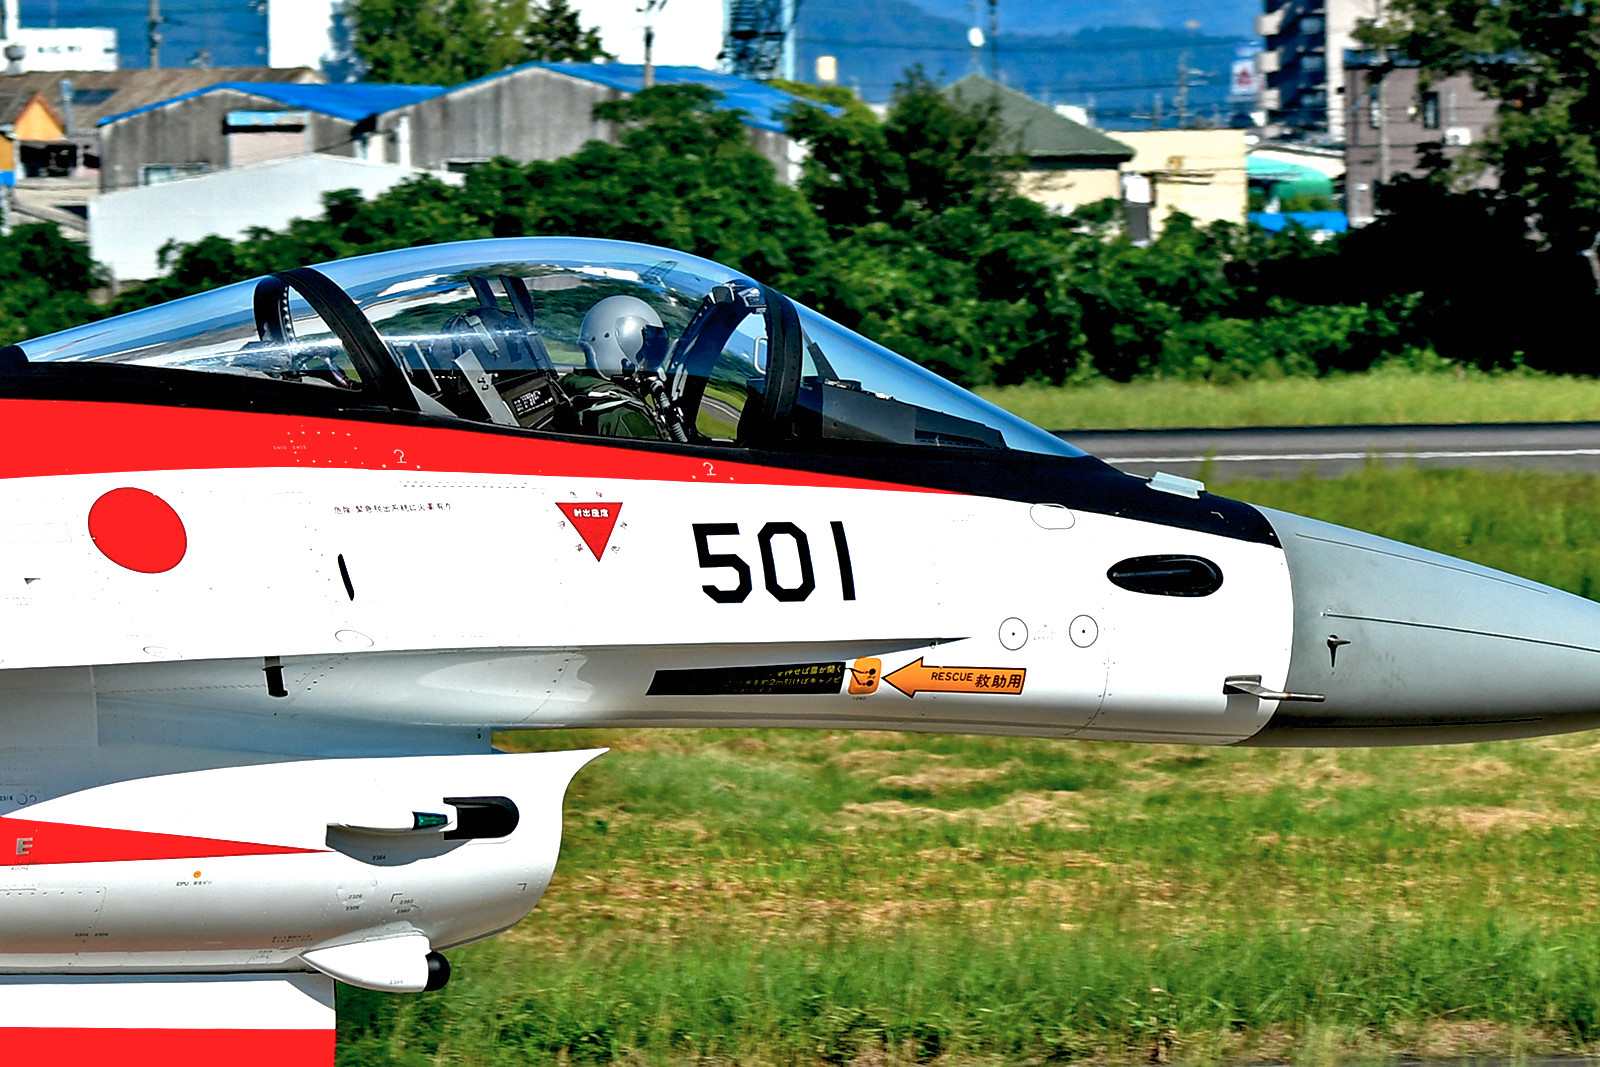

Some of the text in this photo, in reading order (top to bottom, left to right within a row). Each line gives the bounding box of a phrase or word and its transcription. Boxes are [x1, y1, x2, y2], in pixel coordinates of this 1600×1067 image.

[692, 521, 856, 603] 501
[931, 671, 1022, 688] RESCUE 救助用
